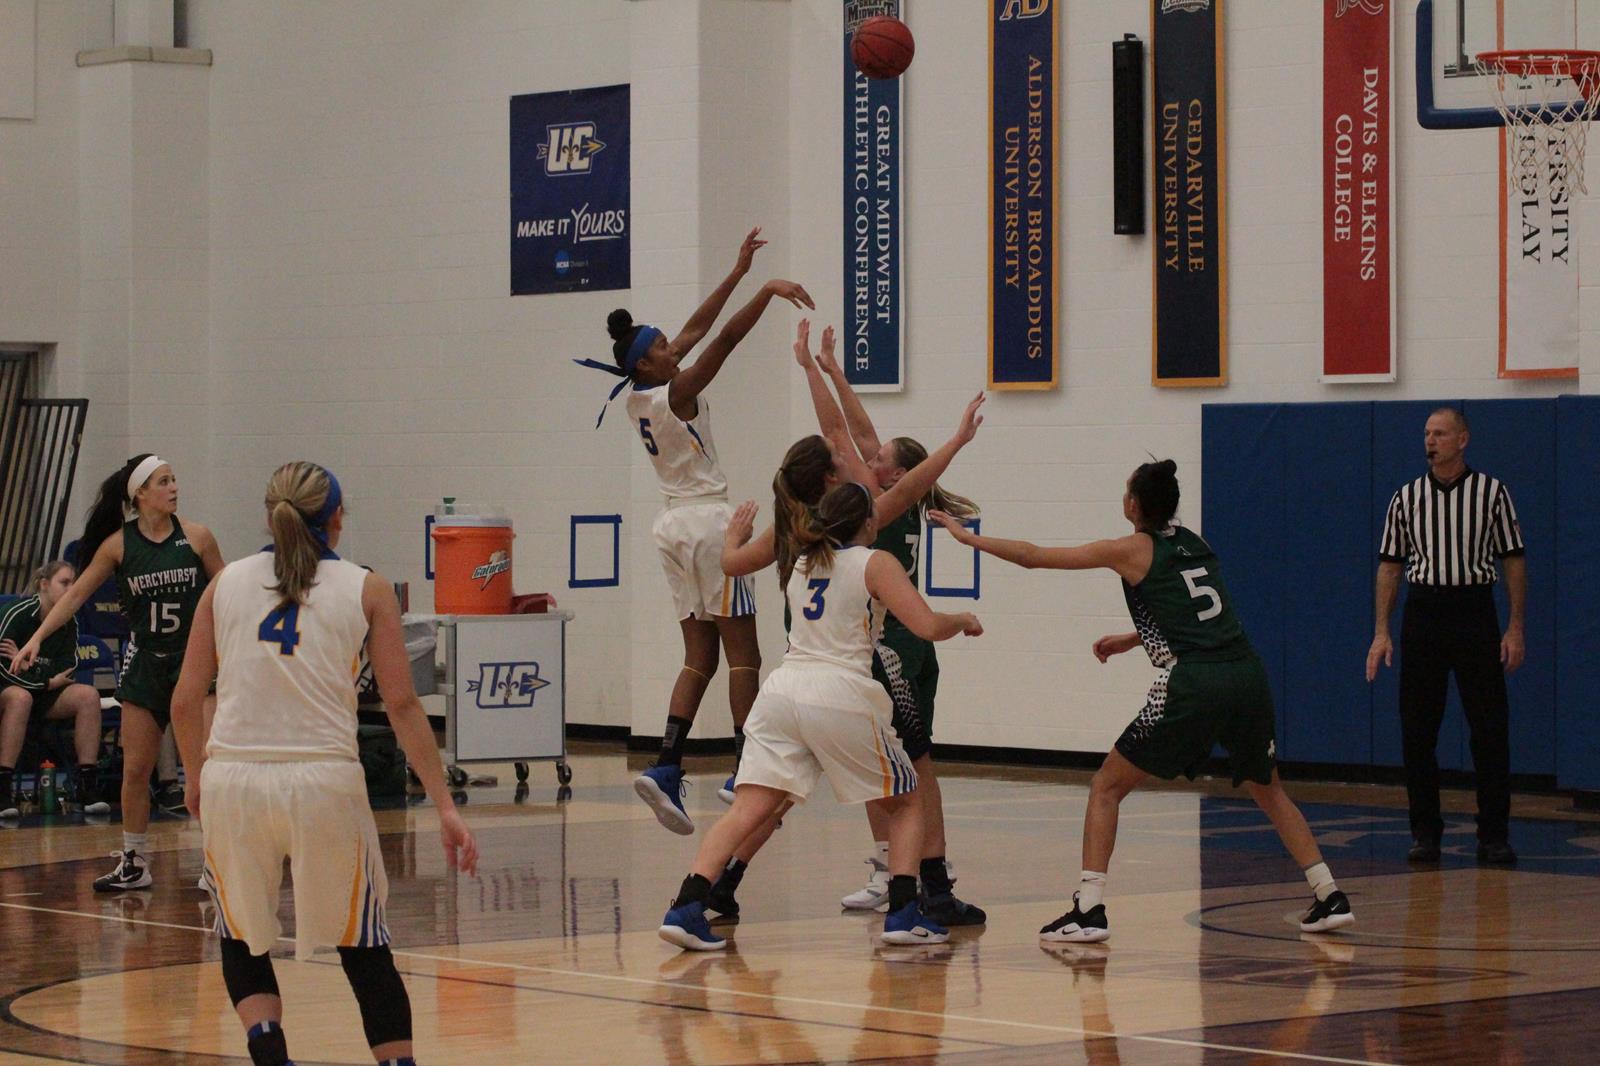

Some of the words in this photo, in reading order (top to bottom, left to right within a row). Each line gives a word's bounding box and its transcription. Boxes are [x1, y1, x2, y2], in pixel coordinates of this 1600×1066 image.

[546, 124, 595, 173] UC
[855, 70, 869, 191] THLETIC
[876, 104, 891, 192] GREAT
[1027, 54, 1043, 199] ALDERSON
[1362, 65, 1379, 147] DAVIS
[1162, 101, 1180, 273] UNIVERSITY
[1187, 98, 1205, 274] CEDARVILLE
[1334, 113, 1353, 243] COLLEGE
[1361, 151, 1378, 175] &
[516, 218, 554, 238] MAKE
[556, 218, 571, 236] IT
[570, 202, 626, 244] YOURS
[1004, 125, 1020, 290] UNIVERSITY
[1360, 179, 1378, 282] ELKINS
[855, 196, 869, 372] CONFERENCE
[876, 197, 891, 325] MIDWEST
[1027, 208, 1043, 360] BROADDUS
[638, 417, 659, 456] 5
[127, 566, 198, 597] MERCYHURST
[150, 601, 181, 634] 15
[803, 577, 832, 621] 3
[1179, 566, 1223, 622] 5
[257, 598, 301, 657] 4
[477, 663, 538, 708] UC
